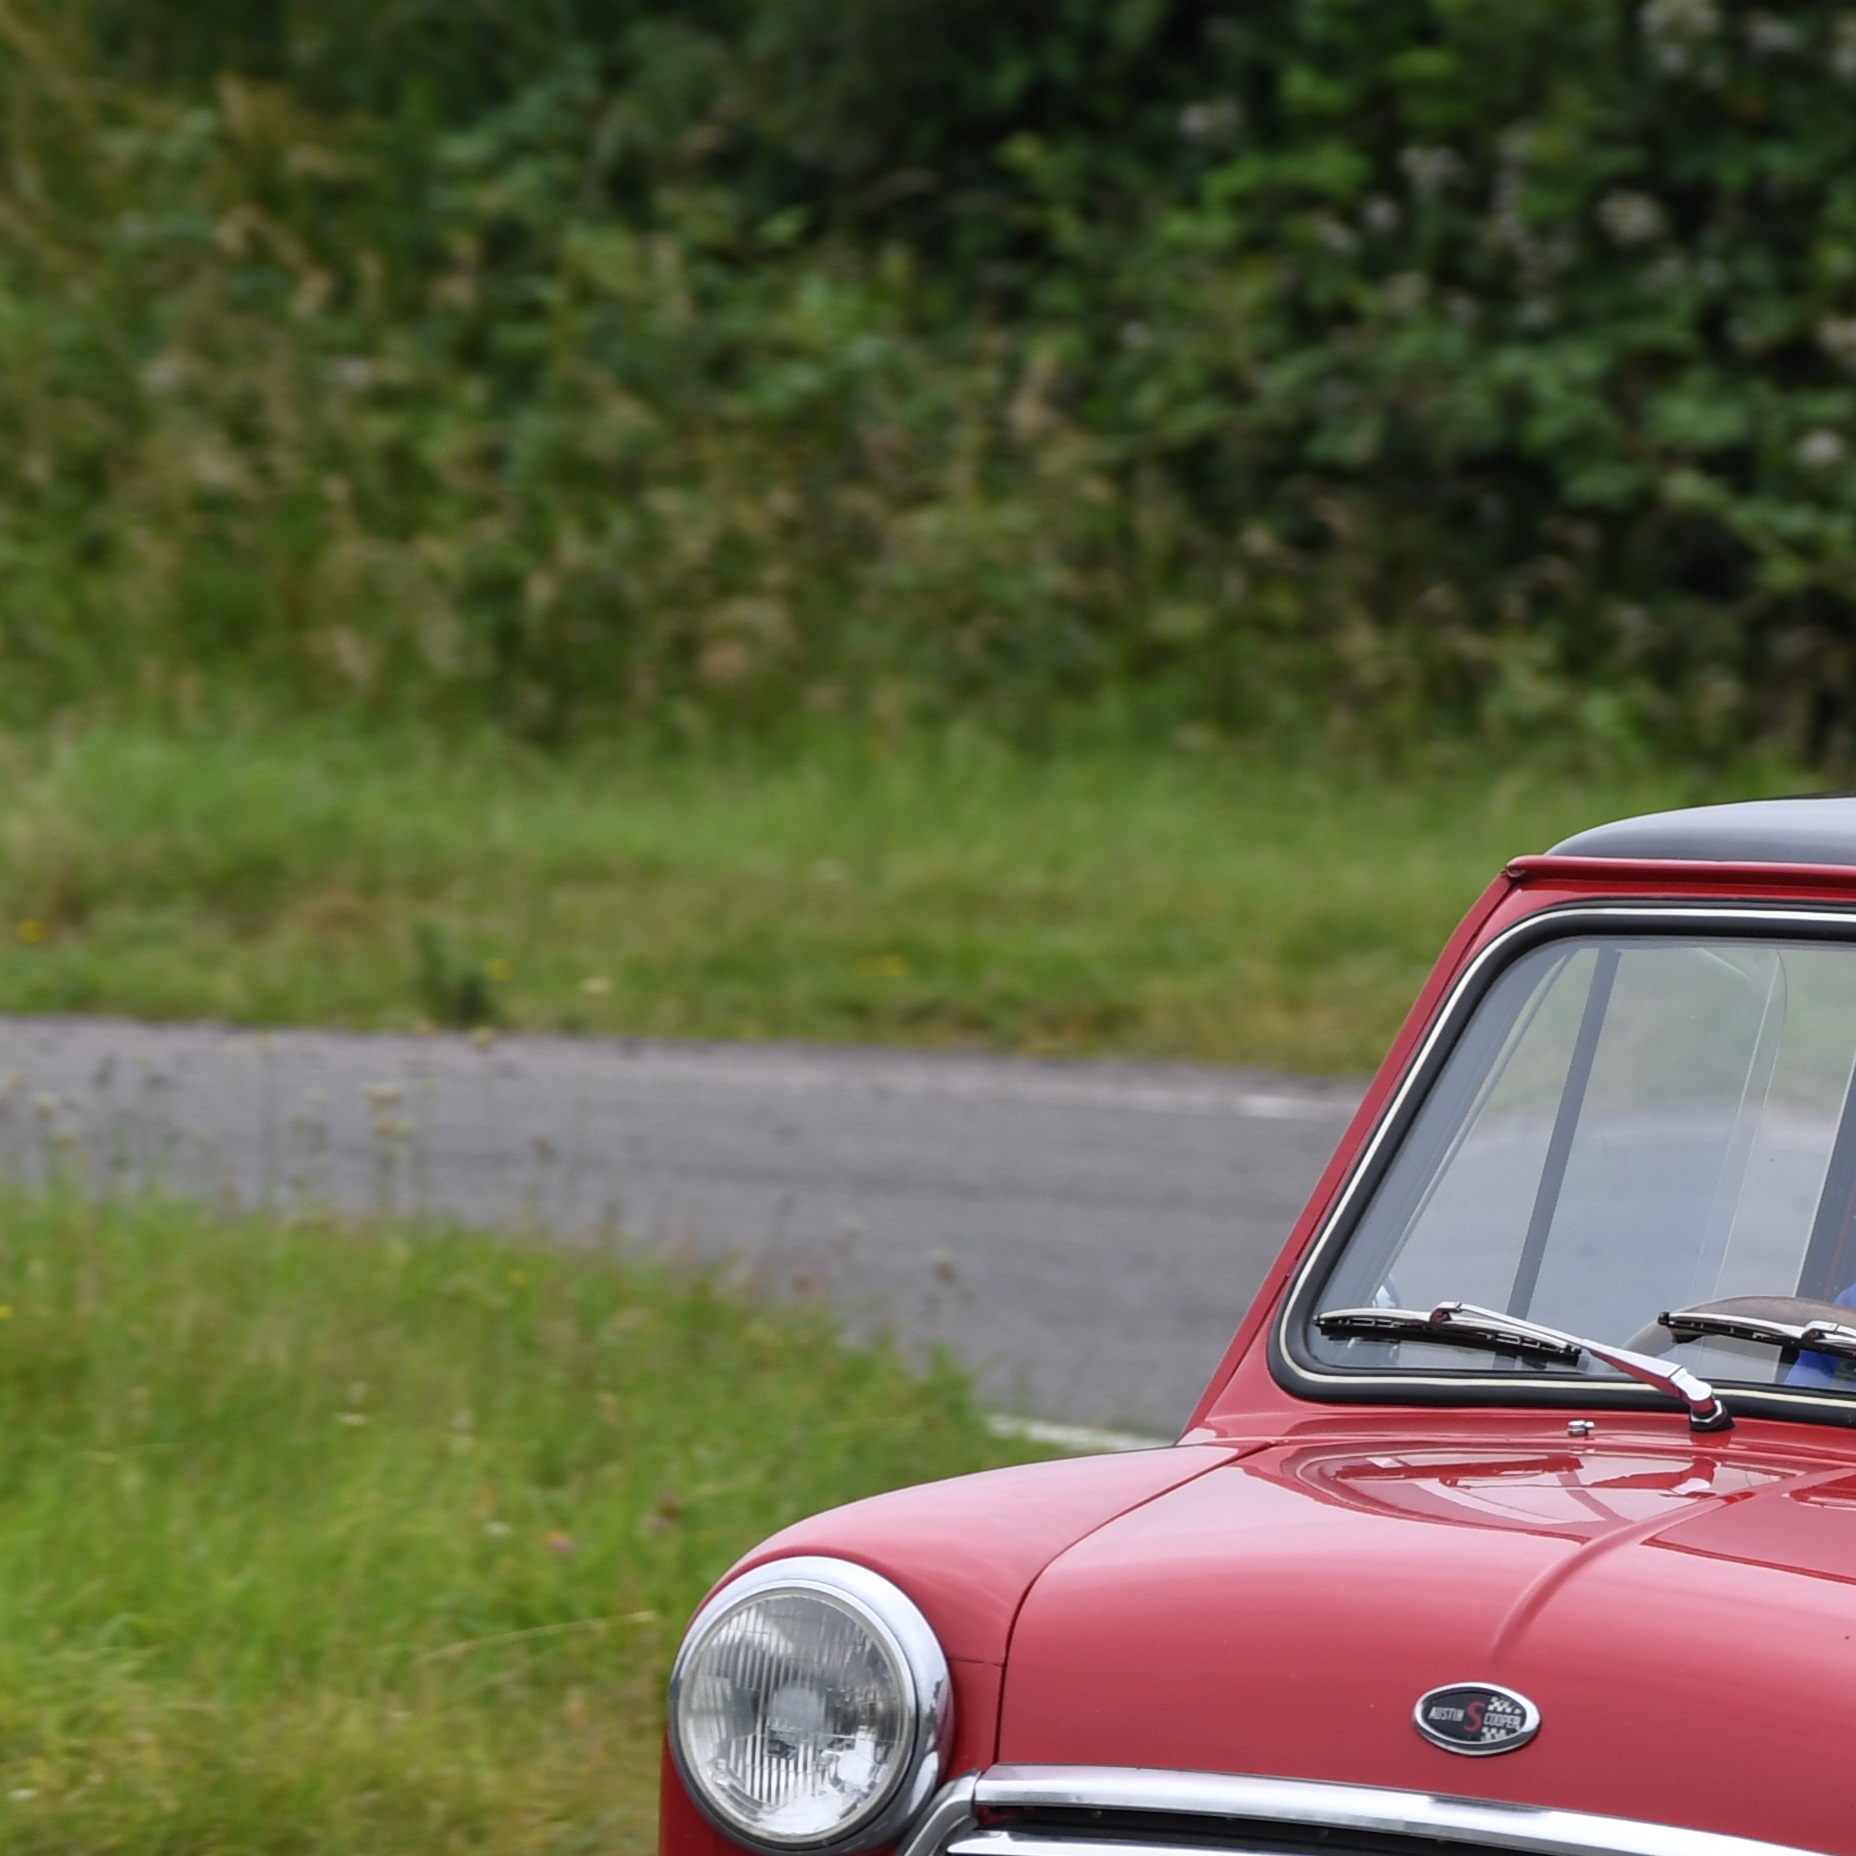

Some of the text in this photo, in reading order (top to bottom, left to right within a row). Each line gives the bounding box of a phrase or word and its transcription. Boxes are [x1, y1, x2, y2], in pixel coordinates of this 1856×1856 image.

[1428, 1701, 1522, 1732] AUSTIN S COOPER
